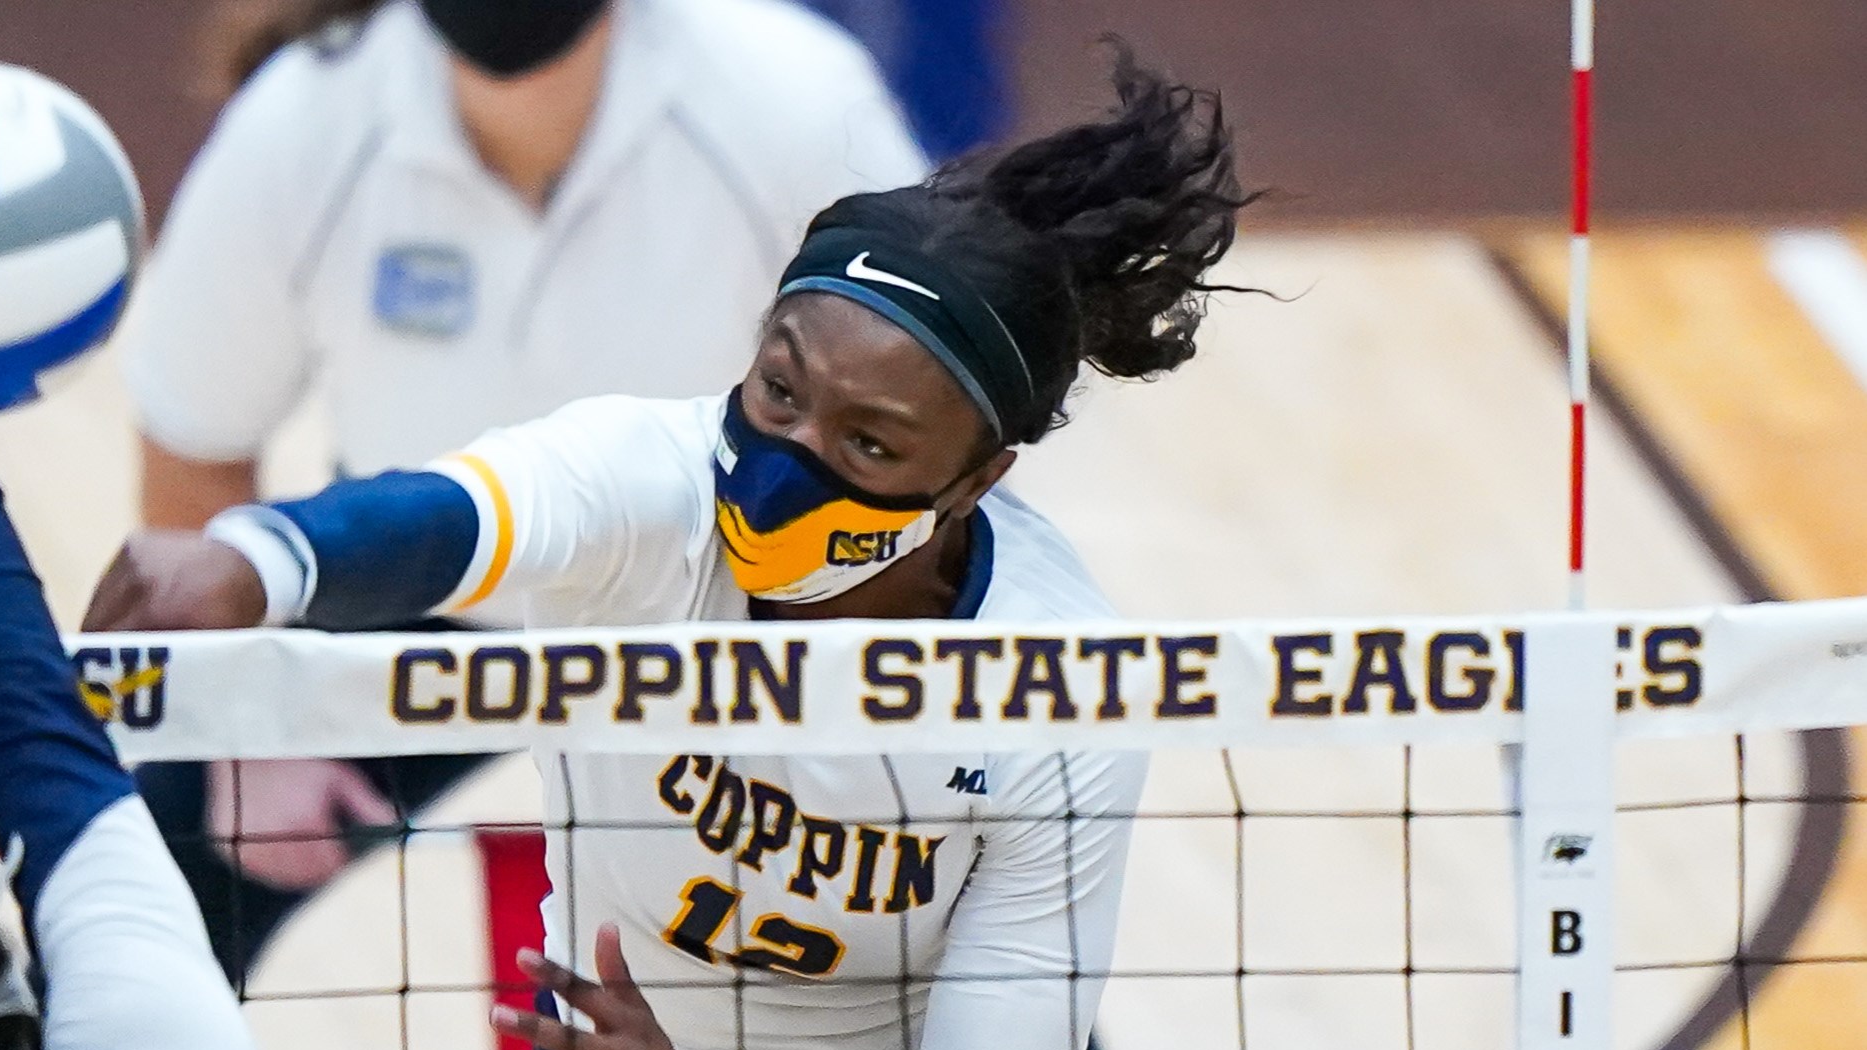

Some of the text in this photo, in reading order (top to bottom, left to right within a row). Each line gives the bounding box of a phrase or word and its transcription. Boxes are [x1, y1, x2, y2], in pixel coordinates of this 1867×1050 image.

[826, 530, 902, 567] CSU
[72, 646, 170, 730] SU
[390, 624, 1704, 725] COPPIN STATE EAGS
[657, 754, 949, 915] COPPIN
[662, 875, 847, 979] 12
